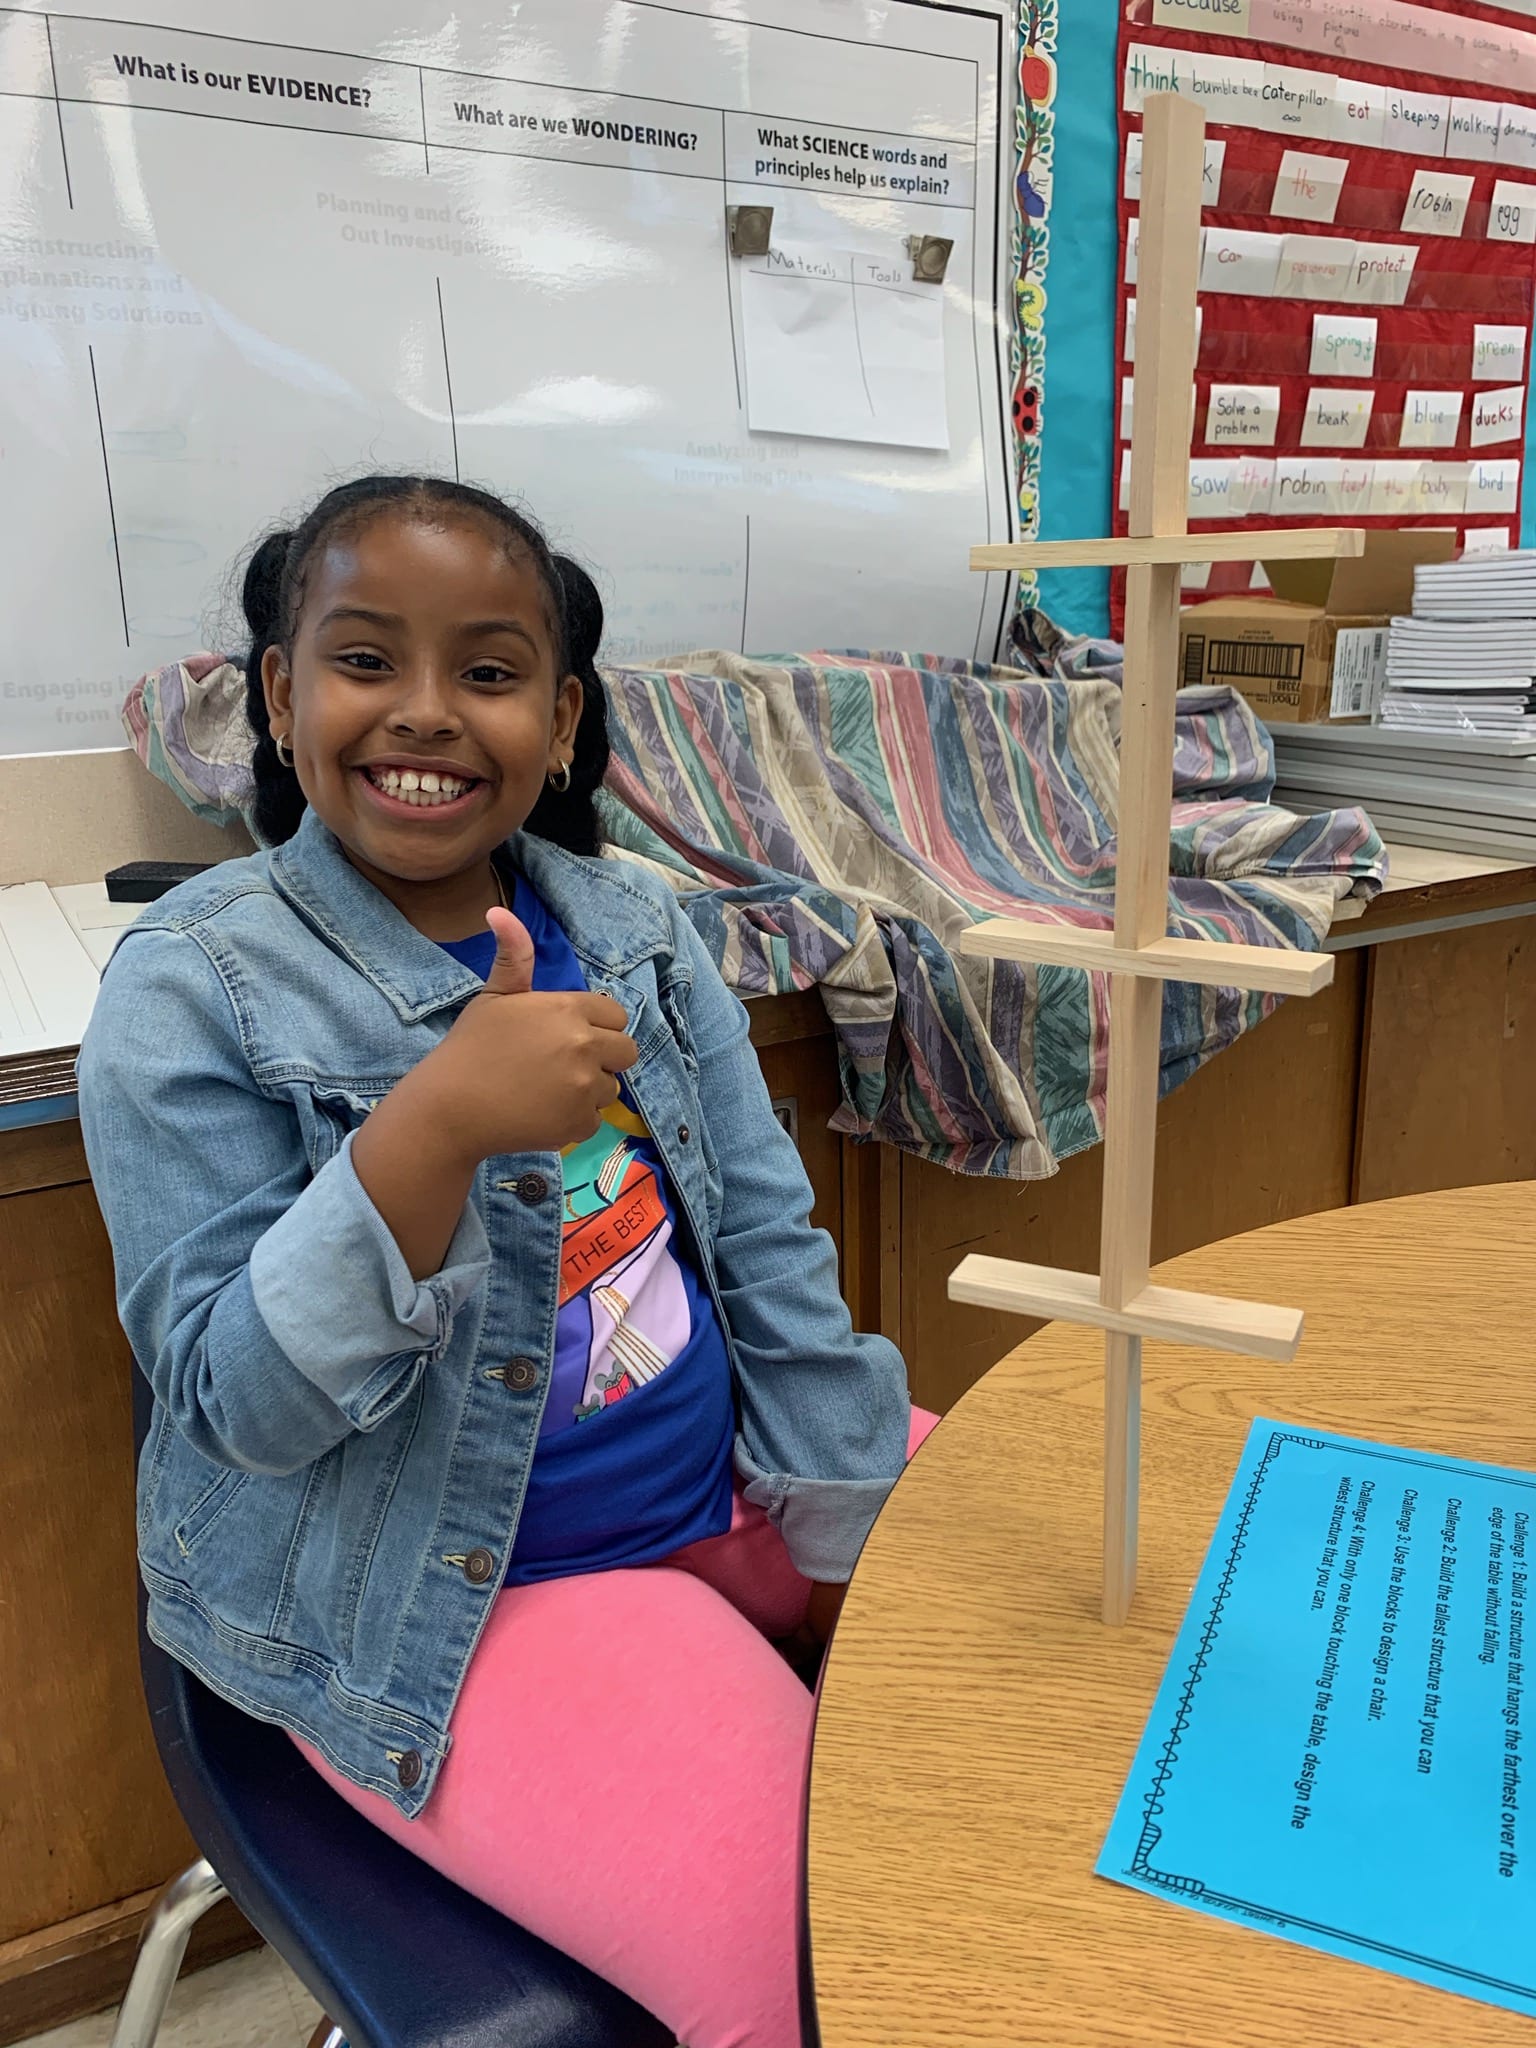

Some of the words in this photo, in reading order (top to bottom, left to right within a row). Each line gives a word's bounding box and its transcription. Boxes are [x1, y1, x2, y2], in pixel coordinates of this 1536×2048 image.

[114, 54, 176, 83] What
[181, 62, 199, 86] is
[205, 71, 241, 92] our
[247, 73, 371, 109] EVIDENCE?
[1130, 54, 1179, 92] think
[1192, 69, 1238, 95] bumble
[1347, 100, 1370, 120] eat
[455, 102, 504, 128] What
[509, 114, 537, 132] are
[542, 119, 568, 135] we
[572, 118, 698, 151] WONDERING?
[758, 129, 798, 150] What
[802, 135, 869, 160] SCIENCE
[872, 148, 917, 166] words
[920, 153, 948, 169] and
[755, 157, 830, 182] principles
[834, 165, 866, 188] help
[870, 174, 887, 188] us
[890, 175, 949, 195] explain?
[316, 192, 409, 223] Planning
[415, 204, 450, 223] and
[1291, 168, 1317, 199] the
[1497, 204, 1521, 236] egg
[341, 223, 379, 245] Out
[867, 265, 902, 283] Tools
[1357, 253, 1406, 285] protect
[139, 273, 183, 293] and
[92, 301, 204, 326] Solutions
[1478, 341, 1515, 366] green
[1254, 406, 1261, 415] a
[1414, 400, 1444, 424] blue
[1214, 420, 1260, 440] problem
[1279, 468, 1326, 497] robin
[1478, 466, 1504, 491] bird
[3, 677, 113, 701] Engaging
[56, 706, 109, 724] from
[565, 1233, 616, 1274] THE
[612, 1197, 649, 1239] BEST
[1336, 1476, 1354, 1504] widest
[1352, 1480, 1376, 1523] Challenge
[1396, 1488, 1418, 1532] Challenge
[1441, 1498, 1462, 1542] Challenge
[1487, 1507, 1504, 1529] edge
[1327, 1503, 1347, 1546] structure
[1352, 1526, 1367, 1534] 4:
[1490, 1531, 1505, 1543] of
[1510, 1513, 1529, 1558] Challenge
[1349, 1534, 1365, 1557] With
[1399, 1535, 1412, 1544] 3:
[1443, 1545, 1457, 1554] 2:
[1490, 1543, 1505, 1558] the
[1321, 1547, 1339, 1568] that
[1393, 1546, 1410, 1564] Use
[1513, 1561, 1528, 1570] 1:
[1316, 1567, 1331, 1588] you
[1339, 1559, 1358, 1582] only
[1390, 1567, 1406, 1583] the
[1440, 1556, 1456, 1584] Build
[1488, 1560, 1504, 1585] table
[1337, 1583, 1352, 1603] one
[1437, 1584, 1453, 1600] the
[1511, 1571, 1528, 1599] Build
[1311, 1590, 1326, 1611] can.
[1384, 1586, 1404, 1620] blocks
[1485, 1588, 1503, 1628] without
[1512, 1600, 1523, 1608] a
[1332, 1605, 1351, 1634] block
[1382, 1621, 1398, 1634] to
[1433, 1603, 1451, 1637] tallest
[1478, 1630, 1501, 1665] falling.
[1509, 1611, 1525, 1659] structure
[1316, 1636, 1344, 1689] touching
[1373, 1636, 1396, 1675] design
[1427, 1634, 1447, 1691] structure
[1374, 1677, 1386, 1686] a
[1508, 1661, 1525, 1687] that
[1315, 1690, 1334, 1711] the
[1368, 1688, 1388, 1722] chair.
[1424, 1693, 1442, 1719] that
[1502, 1688, 1524, 1726] hangs
[1304, 1713, 1329, 1749] table,
[1418, 1720, 1435, 1746] you
[1505, 1729, 1523, 1750] the
[1417, 1748, 1432, 1774] can
[1294, 1753, 1321, 1801] design
[1502, 1753, 1522, 1810] farthest
[1291, 1804, 1311, 1829] the
[1500, 1812, 1516, 1848] over
[1499, 1851, 1518, 1878] the
